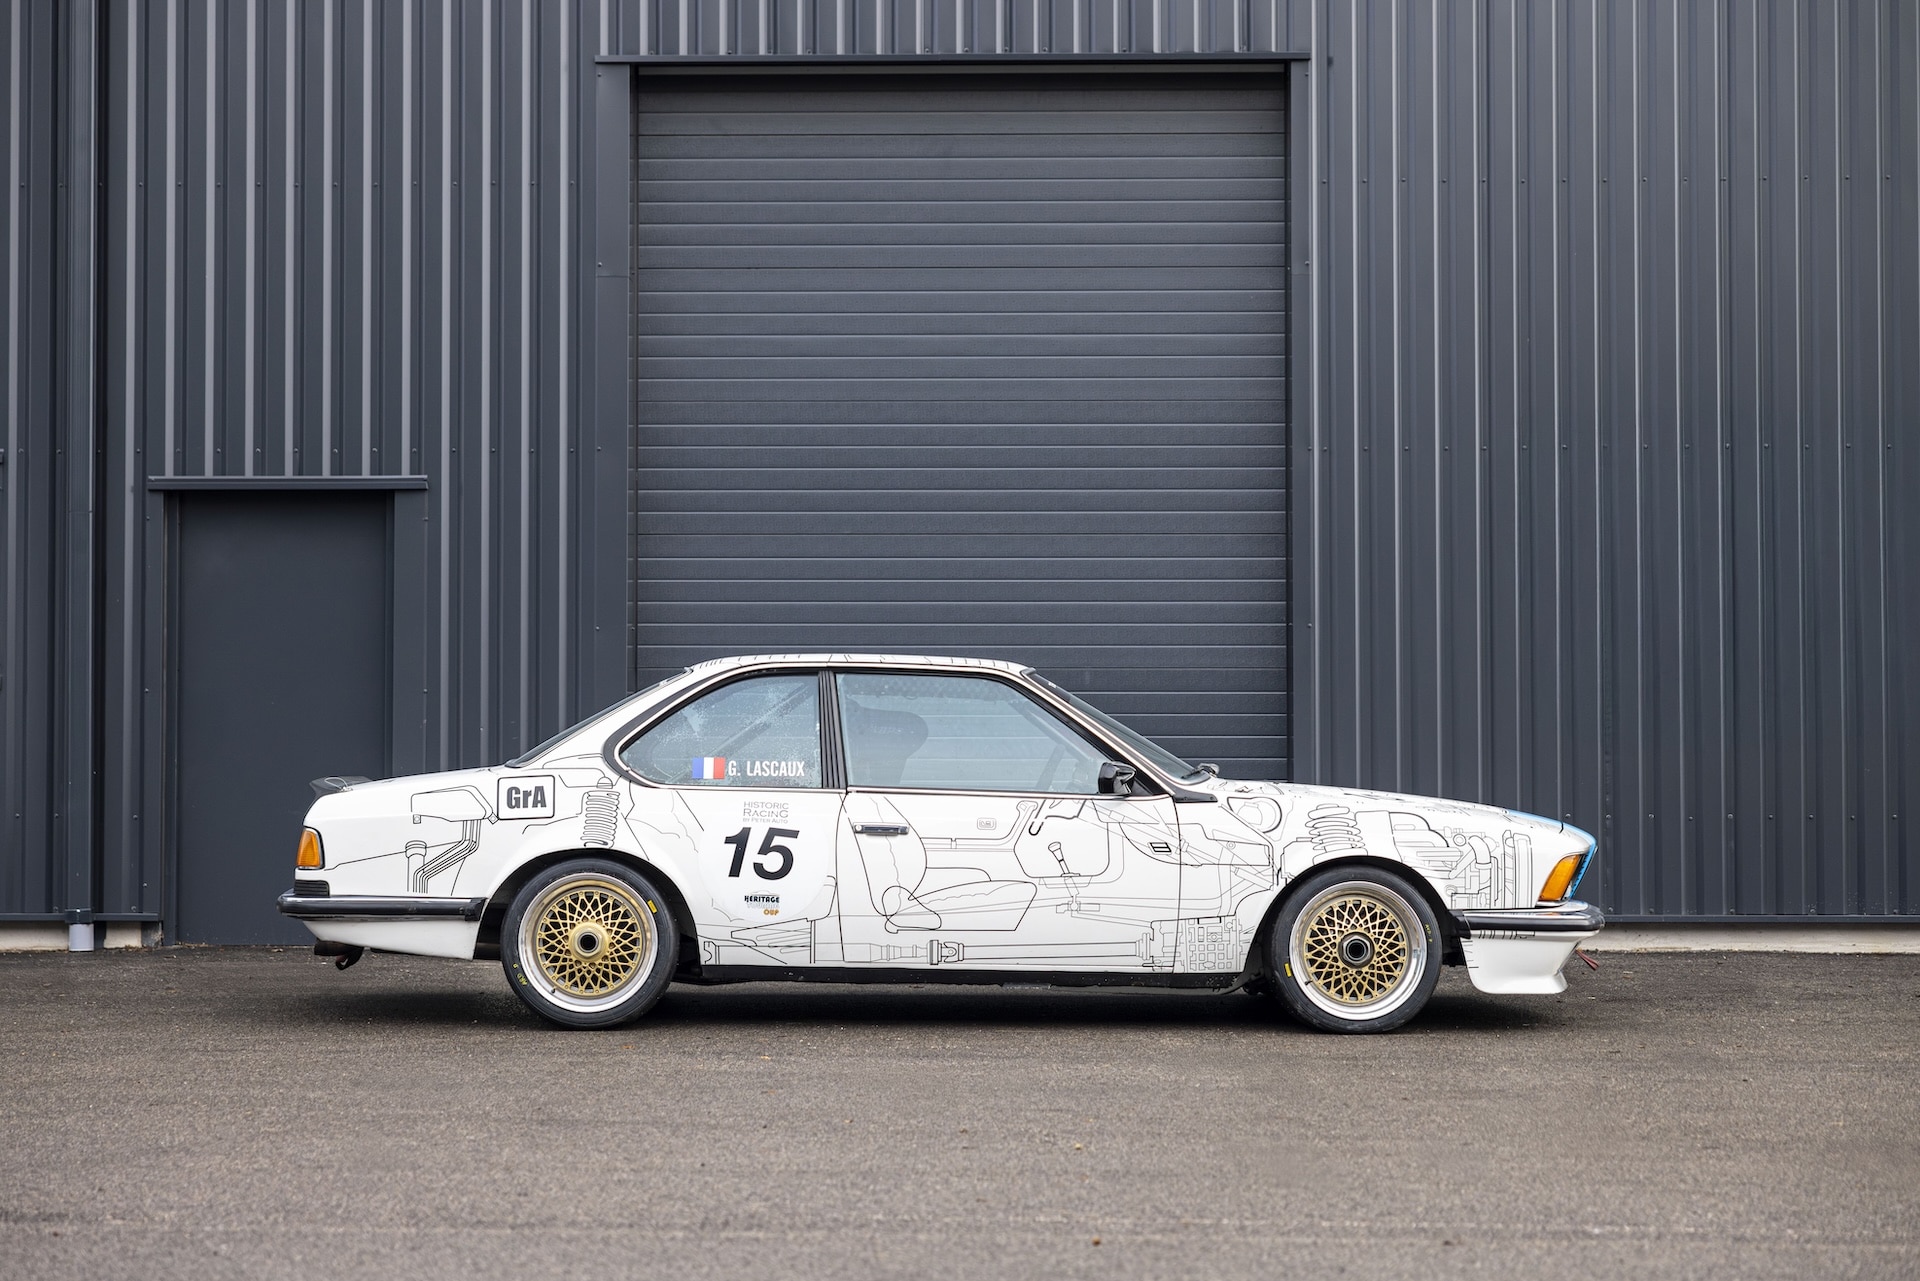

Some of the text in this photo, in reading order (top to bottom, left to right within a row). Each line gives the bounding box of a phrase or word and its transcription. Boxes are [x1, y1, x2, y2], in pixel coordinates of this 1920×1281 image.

[728, 760, 805, 777] G. LASCAUX
[506, 785, 547, 809] GrA
[743, 801, 789, 810] HISTORIC
[724, 826, 800, 881] 15
[744, 895, 780, 904] HERITAGE
